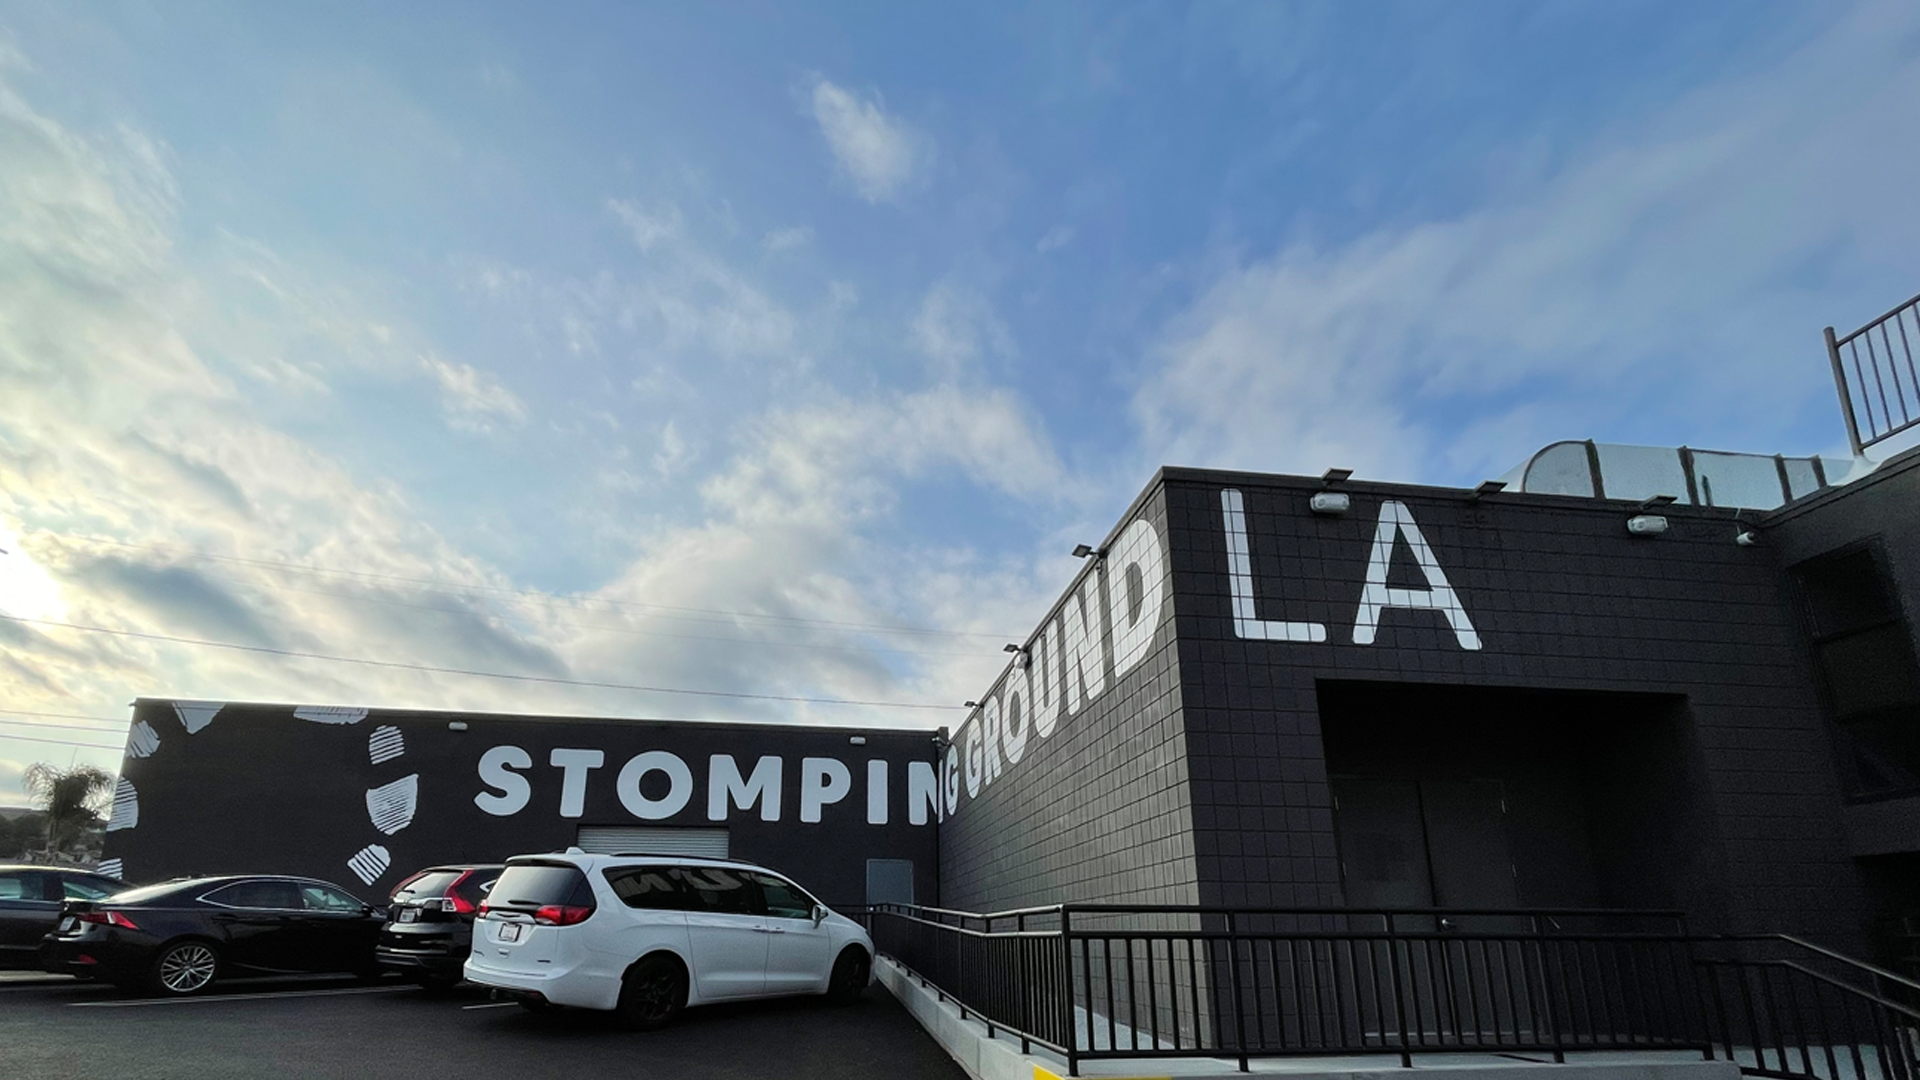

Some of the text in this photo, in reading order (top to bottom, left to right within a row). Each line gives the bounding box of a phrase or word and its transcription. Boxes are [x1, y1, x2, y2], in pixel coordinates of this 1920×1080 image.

[474, 488, 1482, 826] STOMPING GROUND LA
